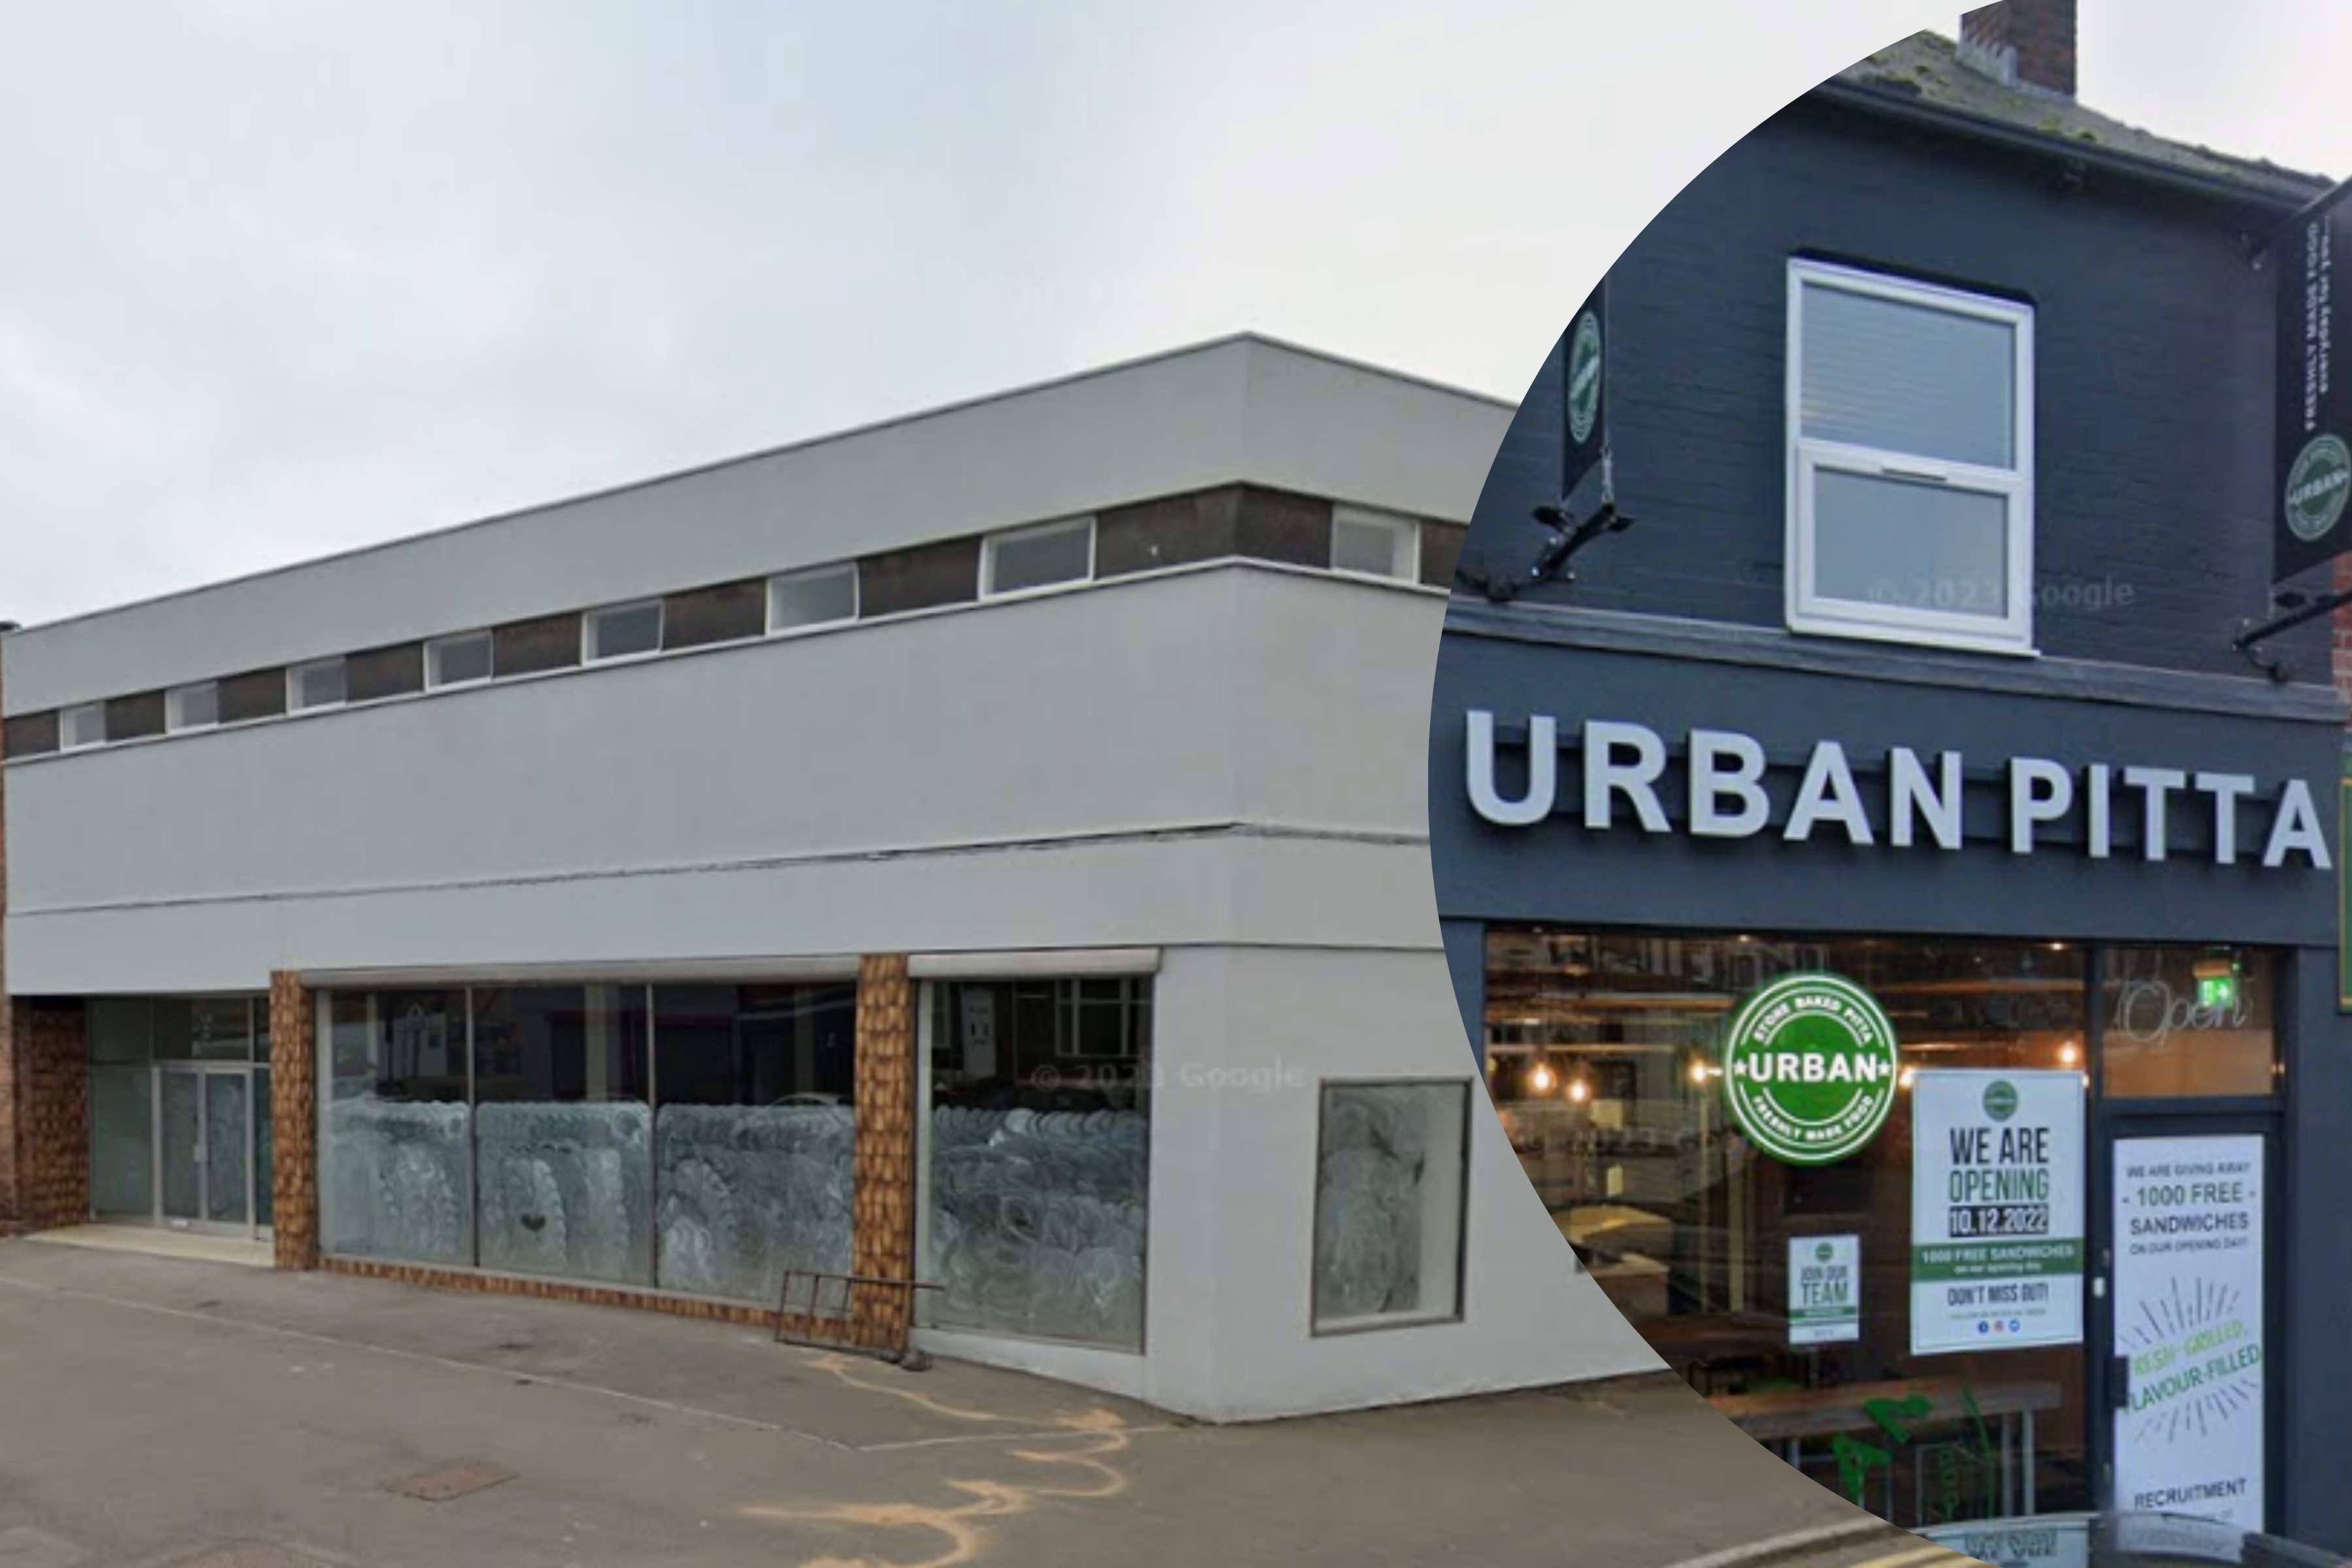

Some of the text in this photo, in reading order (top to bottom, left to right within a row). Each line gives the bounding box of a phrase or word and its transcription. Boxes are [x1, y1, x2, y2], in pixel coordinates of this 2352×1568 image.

[1465, 709, 2333, 870] URBAN PITTA
[2115, 978, 2251, 1047] Open
[1748, 1052, 1878, 1083] URBAN
[1950, 1127, 2050, 1165] WE ARE
[2127, 1161, 2251, 1178] WE ARE GIVING AWAY
[1950, 1167, 2050, 1203] OPENING
[2136, 1181, 2244, 1207] 1000 FREE
[1950, 1207, 2048, 1235] 10.12.2022
[2130, 1211, 2249, 1236] SANDWICHES
[1955, 1247, 1987, 1262] FREE
[1990, 1244, 2076, 1261] SANDWICHES
[2129, 1242, 2147, 1256] ON
[2148, 1241, 2173, 1254] OUR
[2174, 1239, 2222, 1253] OPENING
[1800, 1281, 1848, 1305] TEAM
[1947, 1285, 1986, 1307] DON'T
[1988, 1282, 2019, 1303] MISS
[2133, 1477, 2248, 1511] RECRUITMENT
